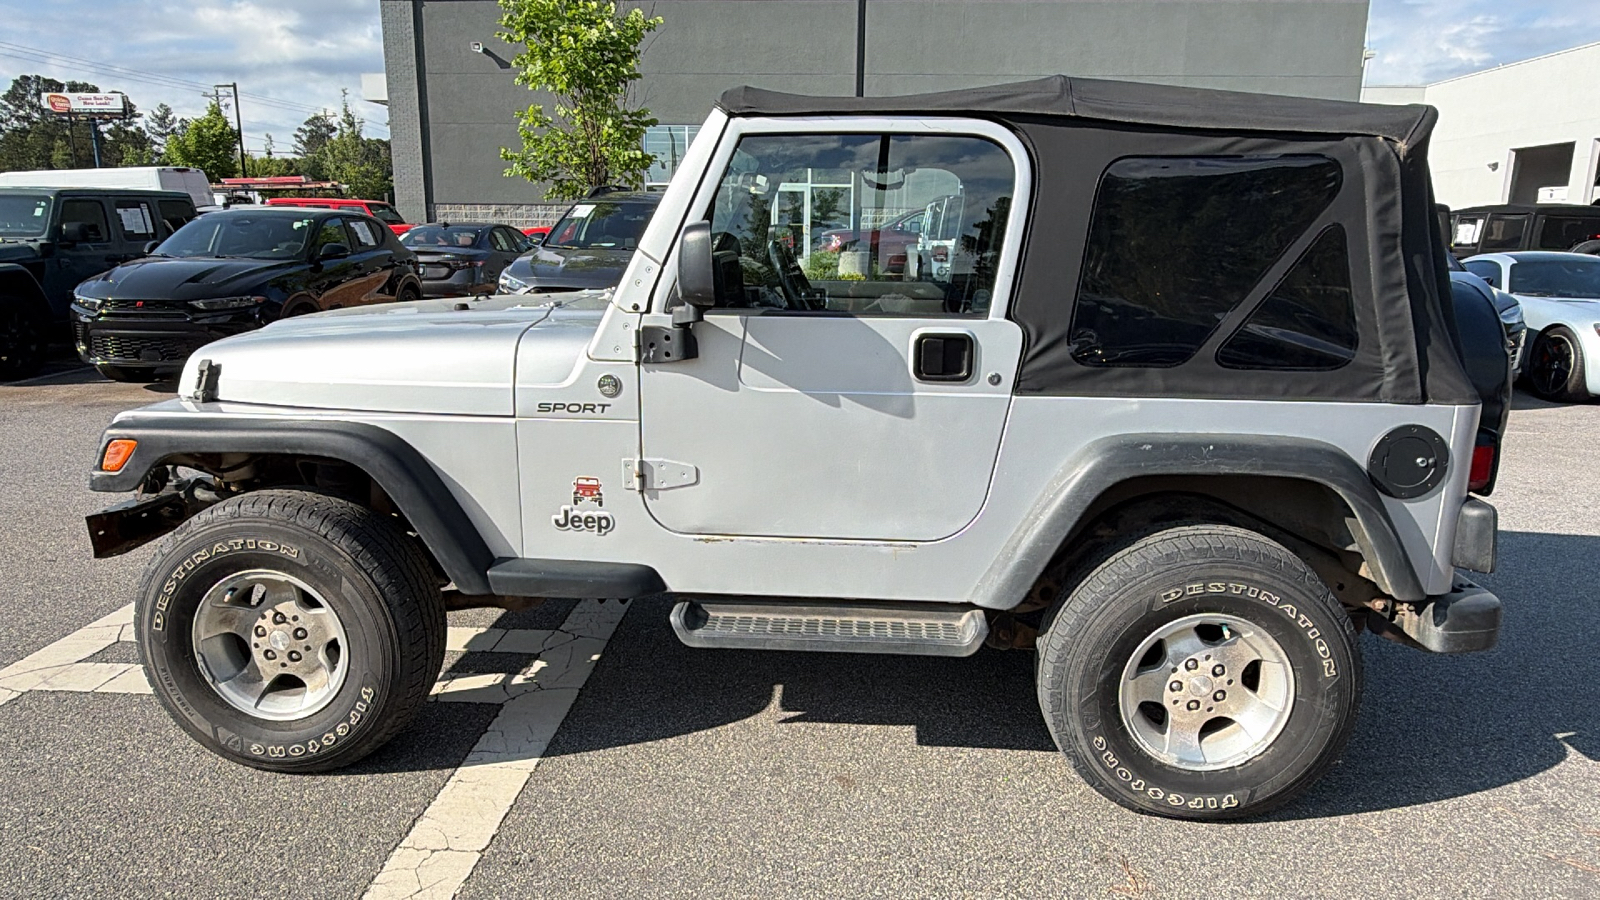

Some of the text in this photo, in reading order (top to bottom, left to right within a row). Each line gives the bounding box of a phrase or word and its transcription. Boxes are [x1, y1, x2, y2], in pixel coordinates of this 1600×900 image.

[536, 402, 612, 414] SPORT
[553, 507, 612, 534] Jeep
[153, 538, 300, 631] DESTINATION
[1161, 582, 1338, 678] DESTINATION
